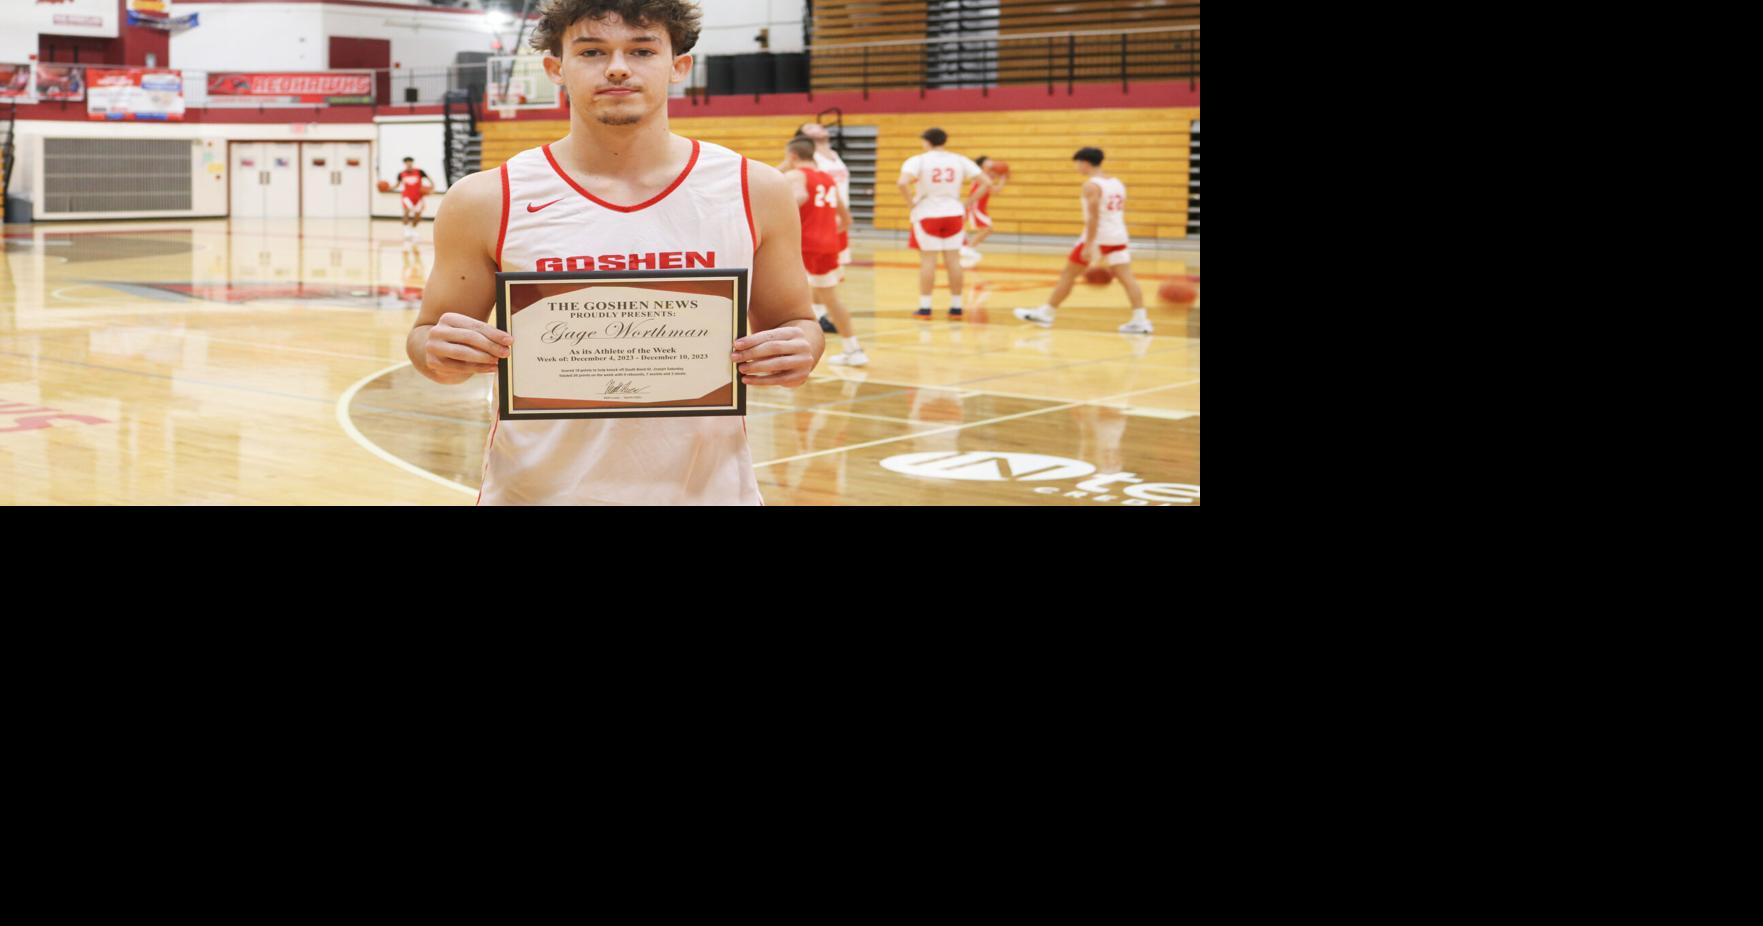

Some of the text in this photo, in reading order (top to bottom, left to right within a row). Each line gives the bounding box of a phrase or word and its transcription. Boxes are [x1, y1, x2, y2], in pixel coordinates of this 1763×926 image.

[932, 168, 955, 183] 23
[536, 251, 715, 273] GOSHEN
[548, 300, 698, 311] THE GOSHEN NEWS
[570, 310, 676, 319] PROUDLY PRESENTS:
[540, 318, 709, 345] Gage Worthman
[1033, 487, 1174, 506] CRED
